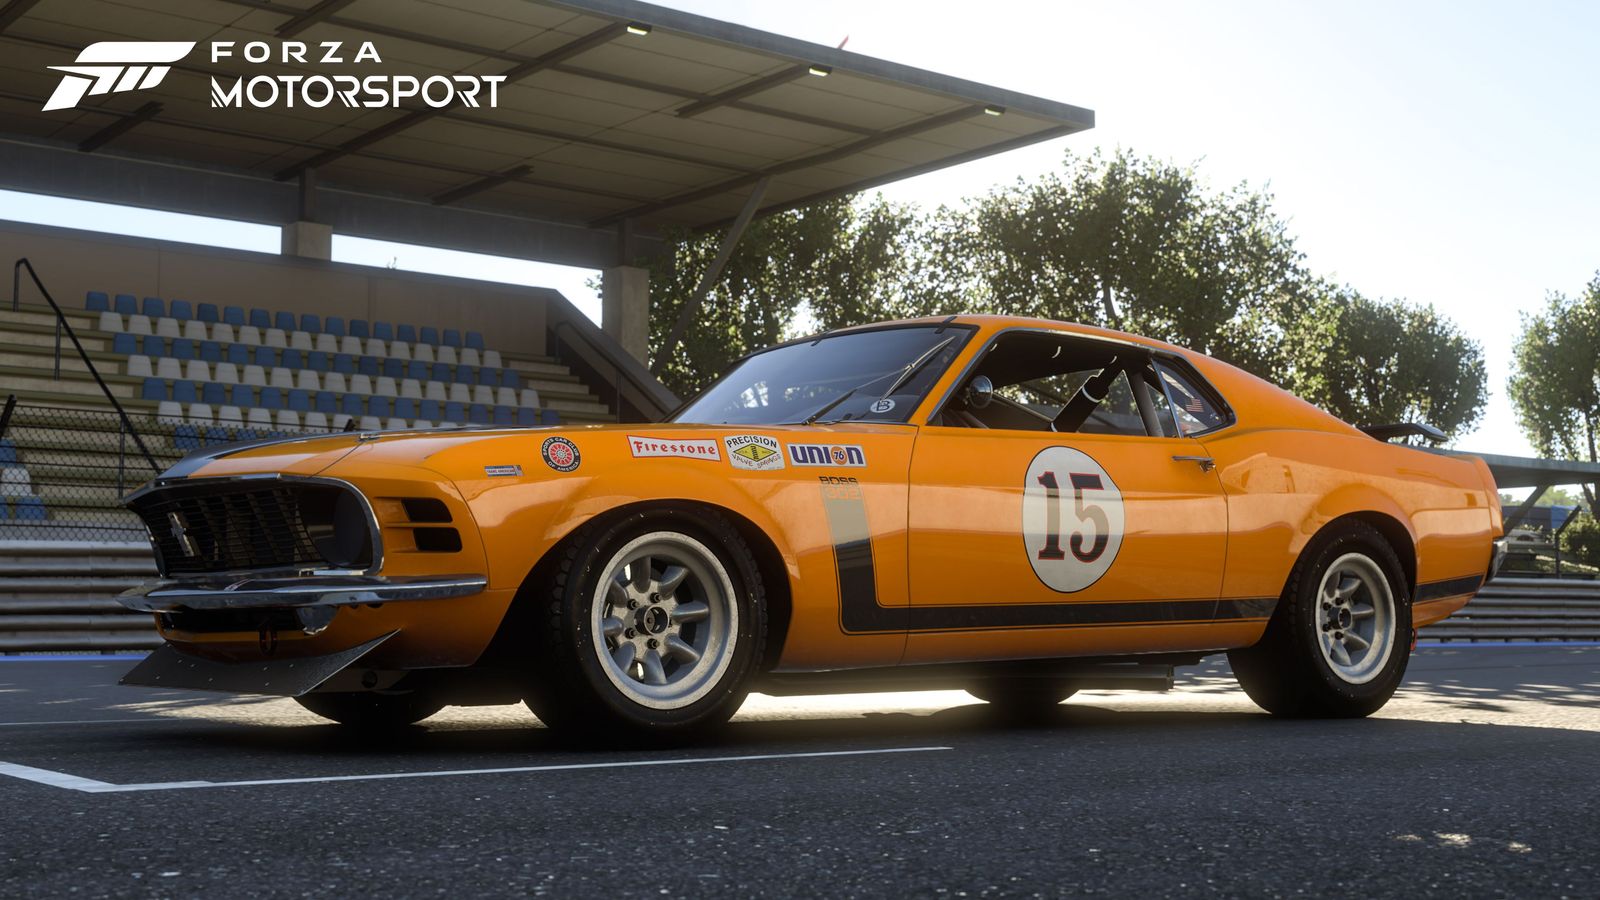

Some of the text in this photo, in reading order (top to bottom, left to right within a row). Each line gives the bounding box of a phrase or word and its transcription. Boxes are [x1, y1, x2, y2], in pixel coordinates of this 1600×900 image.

[633, 440, 716, 455] Firestone
[726, 436, 777, 448] PRECISION
[731, 453, 781, 468] VALVE SPRINGS
[834, 451, 844, 460] 76
[1037, 471, 1109, 563] 15
